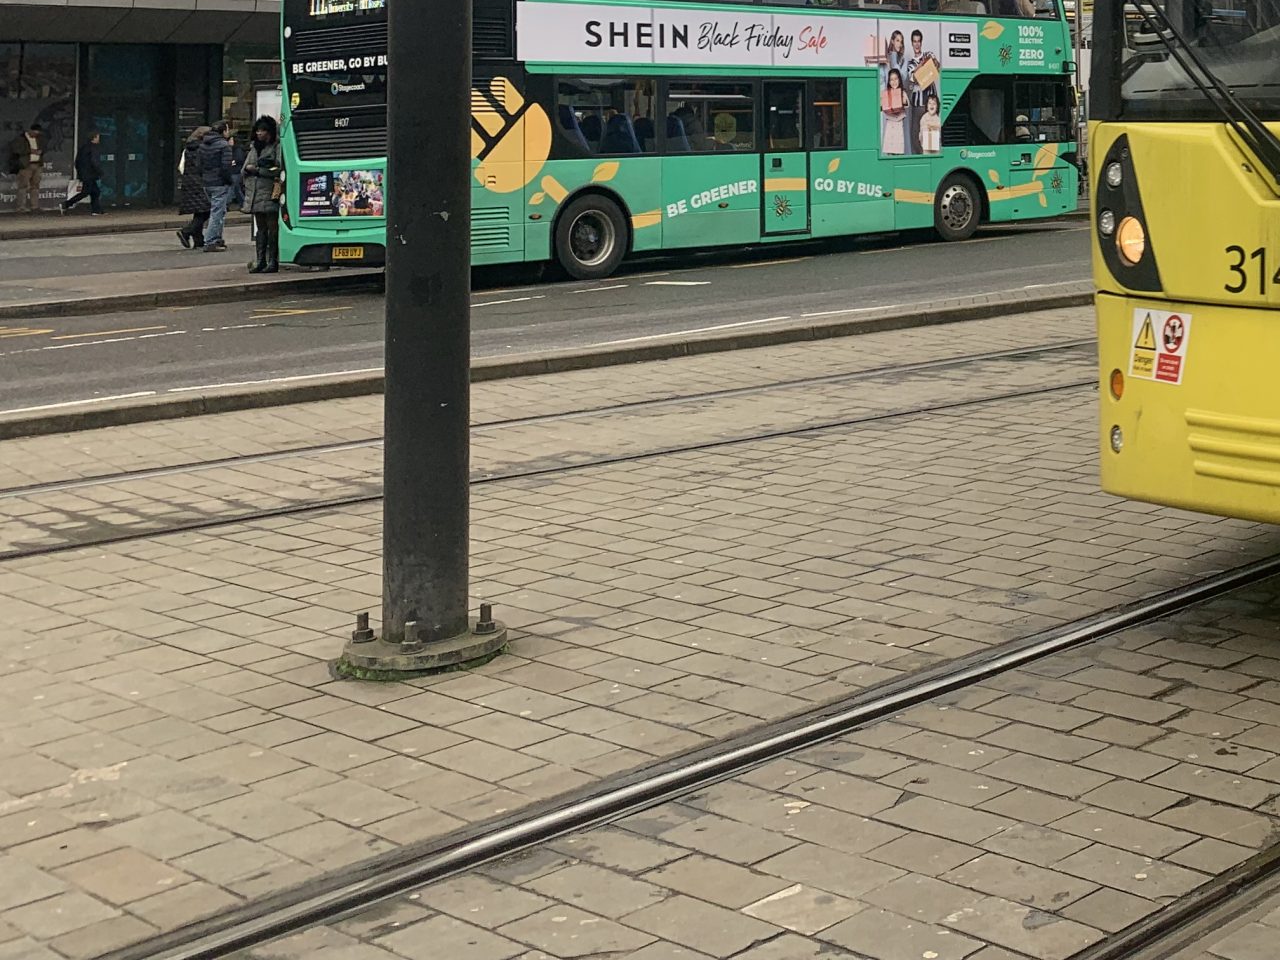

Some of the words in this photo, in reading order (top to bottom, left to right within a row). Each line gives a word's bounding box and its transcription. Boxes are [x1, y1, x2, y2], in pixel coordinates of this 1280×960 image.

[1018, 25, 1044, 37] 100%
[585, 20, 689, 49] SHEIN
[697, 22, 741, 53] Black
[744, 24, 794, 59] Friday
[797, 25, 828, 54] Sale
[1019, 49, 1044, 60] ZERO
[292, 63, 304, 74] BE
[305, 59, 347, 71] GREENER,
[348, 57, 361, 68] GO
[363, 56, 376, 67] BY
[338, 82, 365, 92] Stagecoach
[967, 150, 996, 159] Stagecoach
[814, 177, 834, 192] GO
[837, 180, 854, 195] BY
[857, 180, 882, 197] BUS
[666, 200, 688, 218] BE
[690, 179, 757, 209] GREENER
